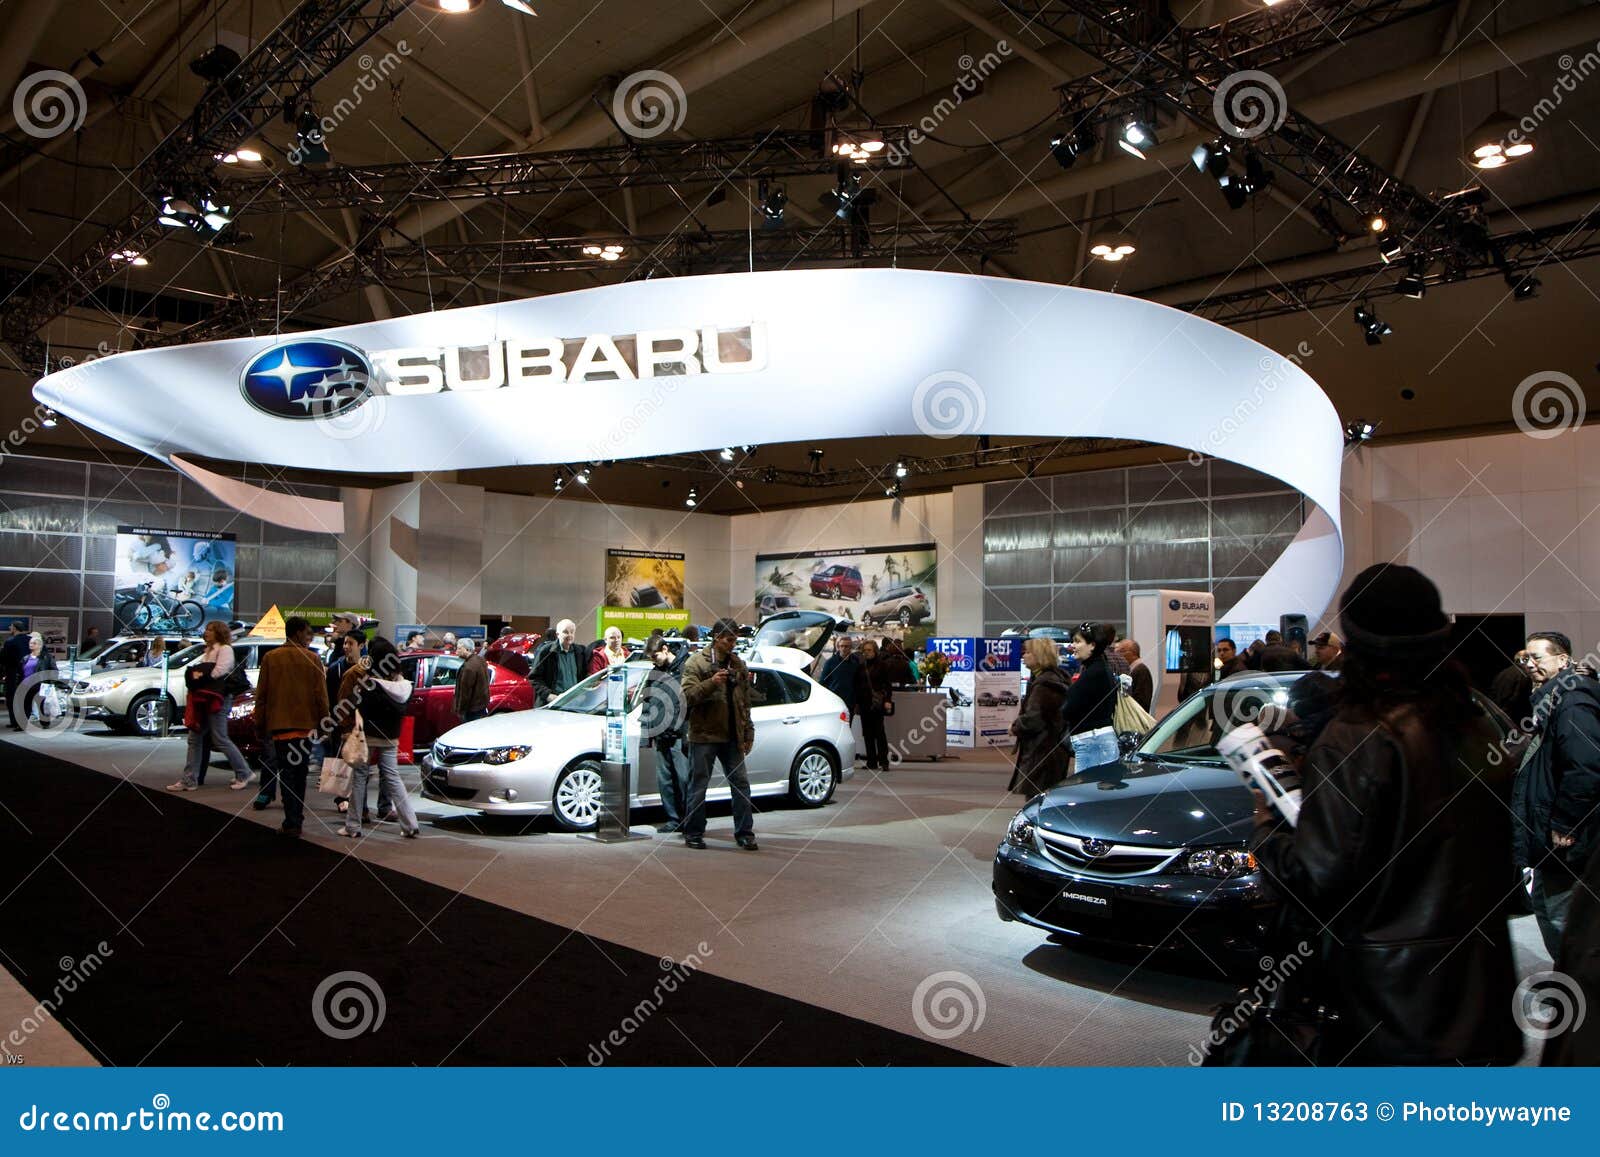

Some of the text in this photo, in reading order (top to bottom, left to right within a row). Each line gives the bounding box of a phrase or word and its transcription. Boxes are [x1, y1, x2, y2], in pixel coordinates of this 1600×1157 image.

[384, 321, 768, 396] SUBARU
[1182, 601, 1209, 611] SUBARU
[625, 611, 645, 619] HYBRID
[664, 613, 688, 621] CONCEPT
[933, 639, 967, 656] TEST
[984, 639, 1012, 656] TEST
[1062, 891, 1107, 905] IMPREZA
